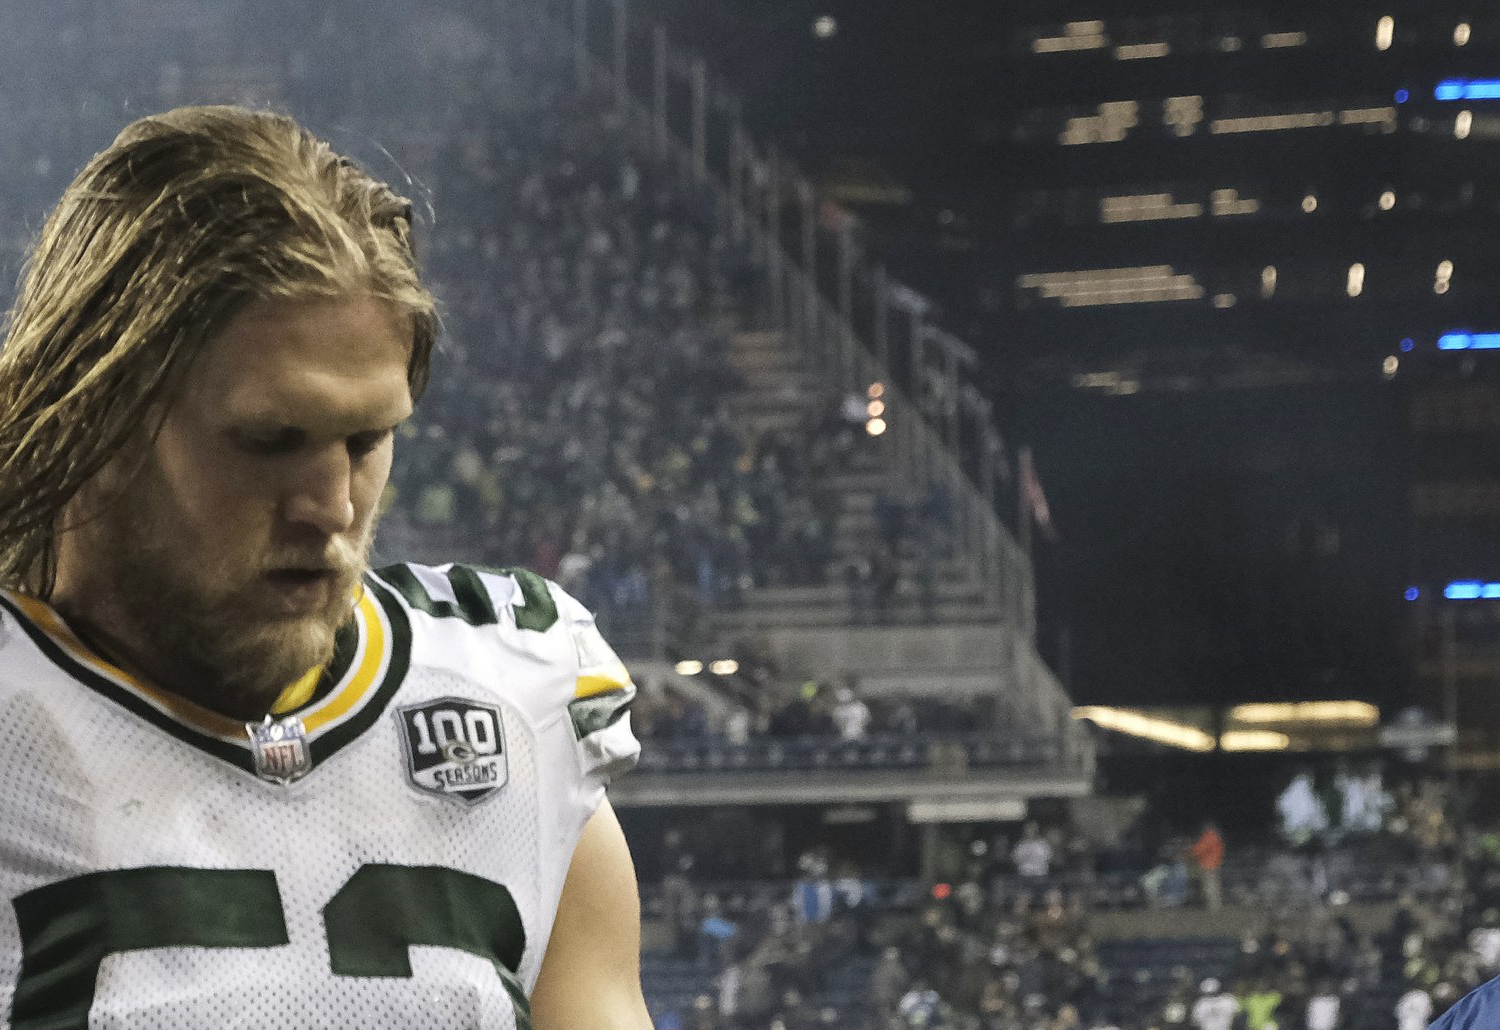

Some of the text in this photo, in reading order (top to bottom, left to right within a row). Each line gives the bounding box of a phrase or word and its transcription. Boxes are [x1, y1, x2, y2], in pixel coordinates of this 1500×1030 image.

[413, 709, 497, 755] 100
[263, 744, 301, 774] NFL
[433, 762, 498, 791] SEASONS
